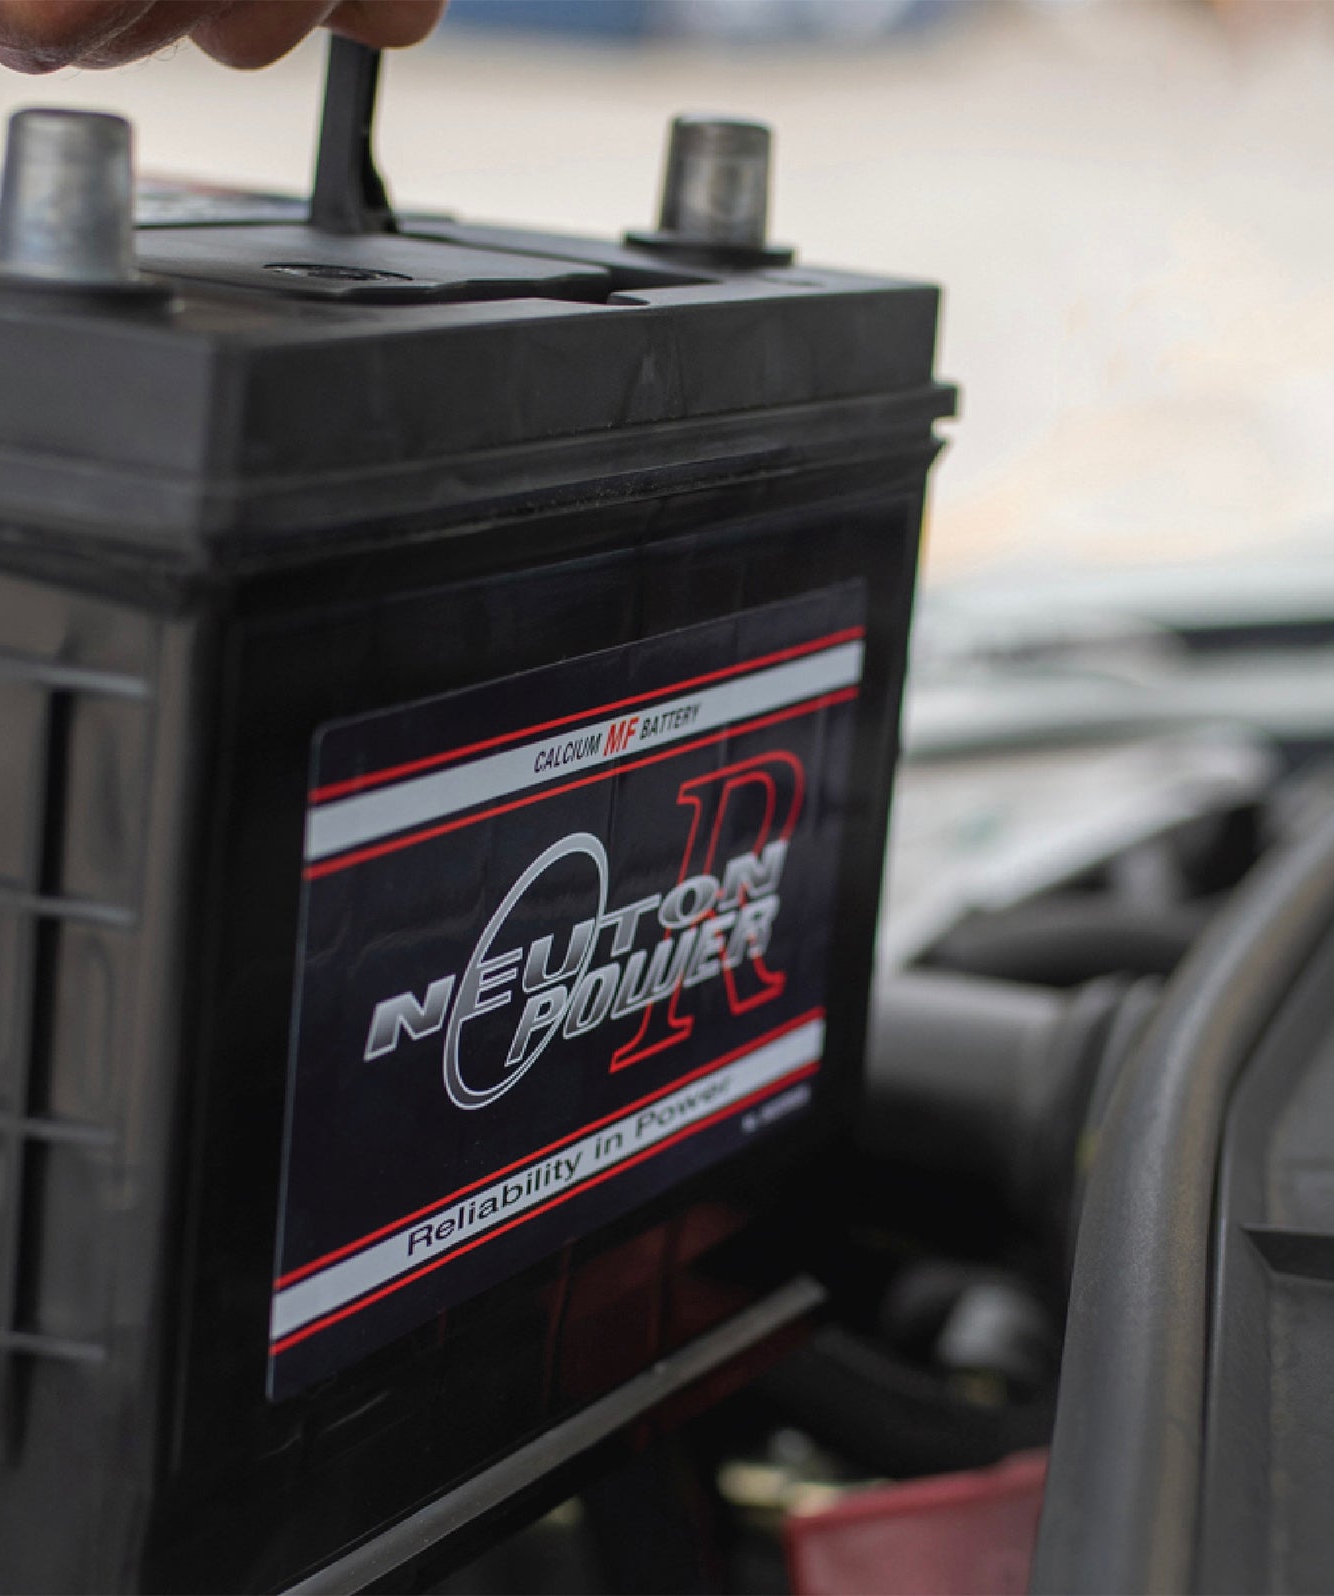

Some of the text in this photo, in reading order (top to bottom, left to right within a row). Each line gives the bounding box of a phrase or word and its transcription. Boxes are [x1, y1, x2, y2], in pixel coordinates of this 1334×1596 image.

[533, 703, 701, 773] CALCIUM MF BATTERY
[364, 840, 788, 1063] NEUTON
[504, 894, 782, 1067] POWER
[407, 1151, 583, 1256] Reliability
[594, 1130, 623, 1160] in
[635, 1075, 732, 1137] Power
